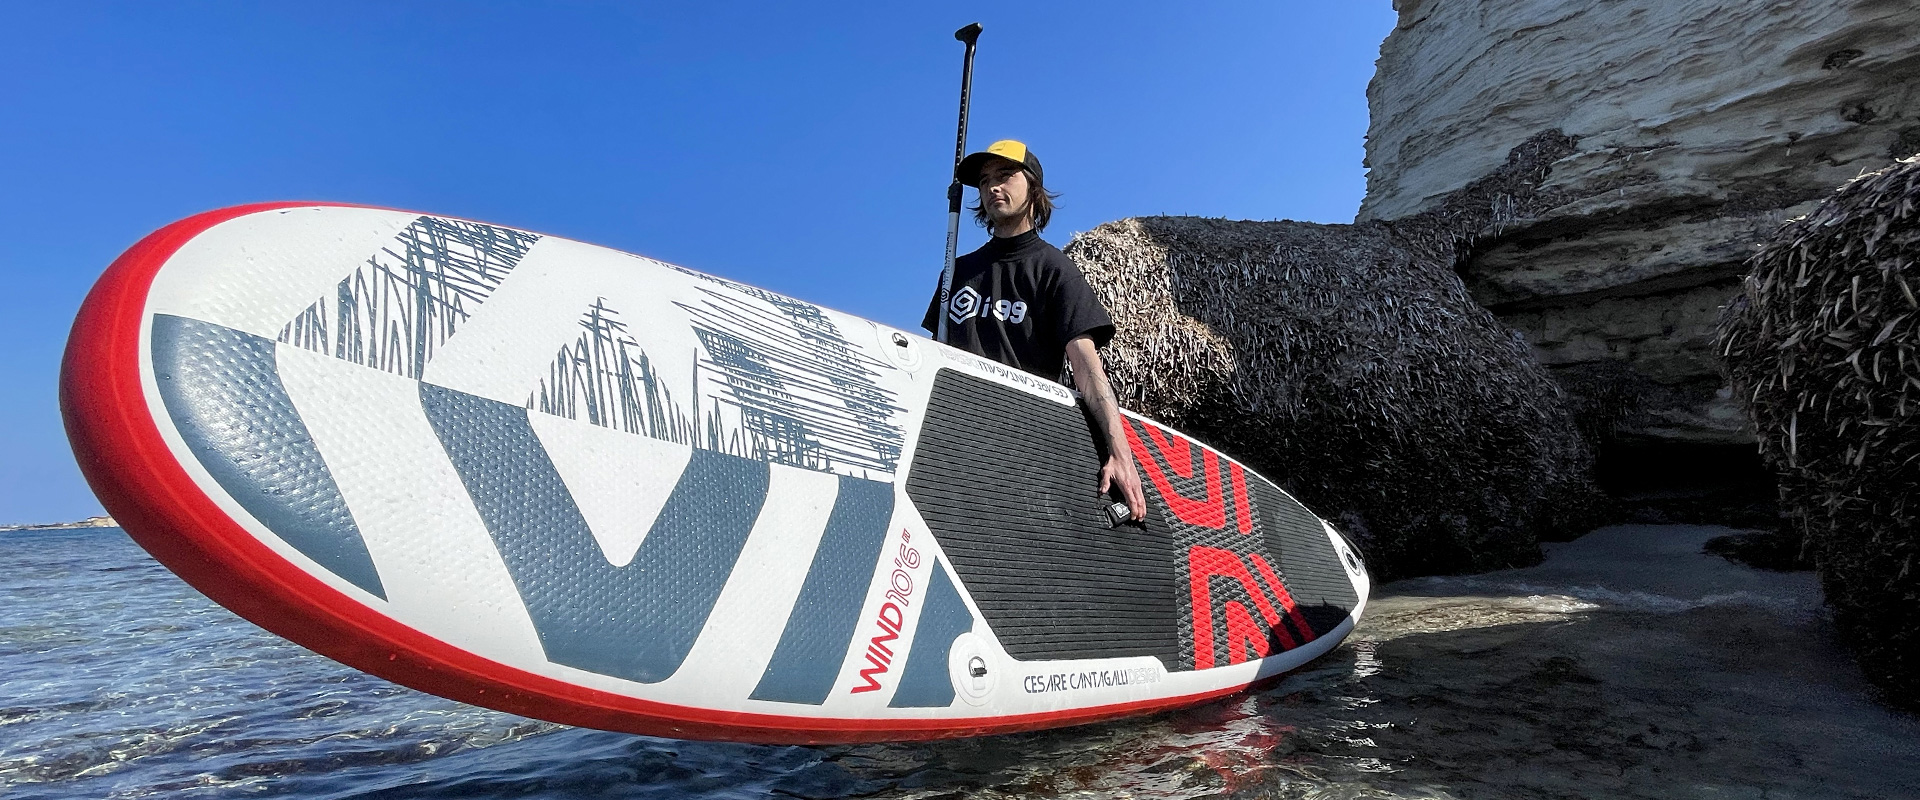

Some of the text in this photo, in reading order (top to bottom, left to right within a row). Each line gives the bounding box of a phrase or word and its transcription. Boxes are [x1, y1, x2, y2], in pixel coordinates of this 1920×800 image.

[979, 360, 1036, 388] CANTAGALLI
[1037, 379, 1069, 399] CESARE
[850, 602, 903, 694] WIND
[1023, 667, 1161, 694] CESARE CANTAGALLI DESIGN
